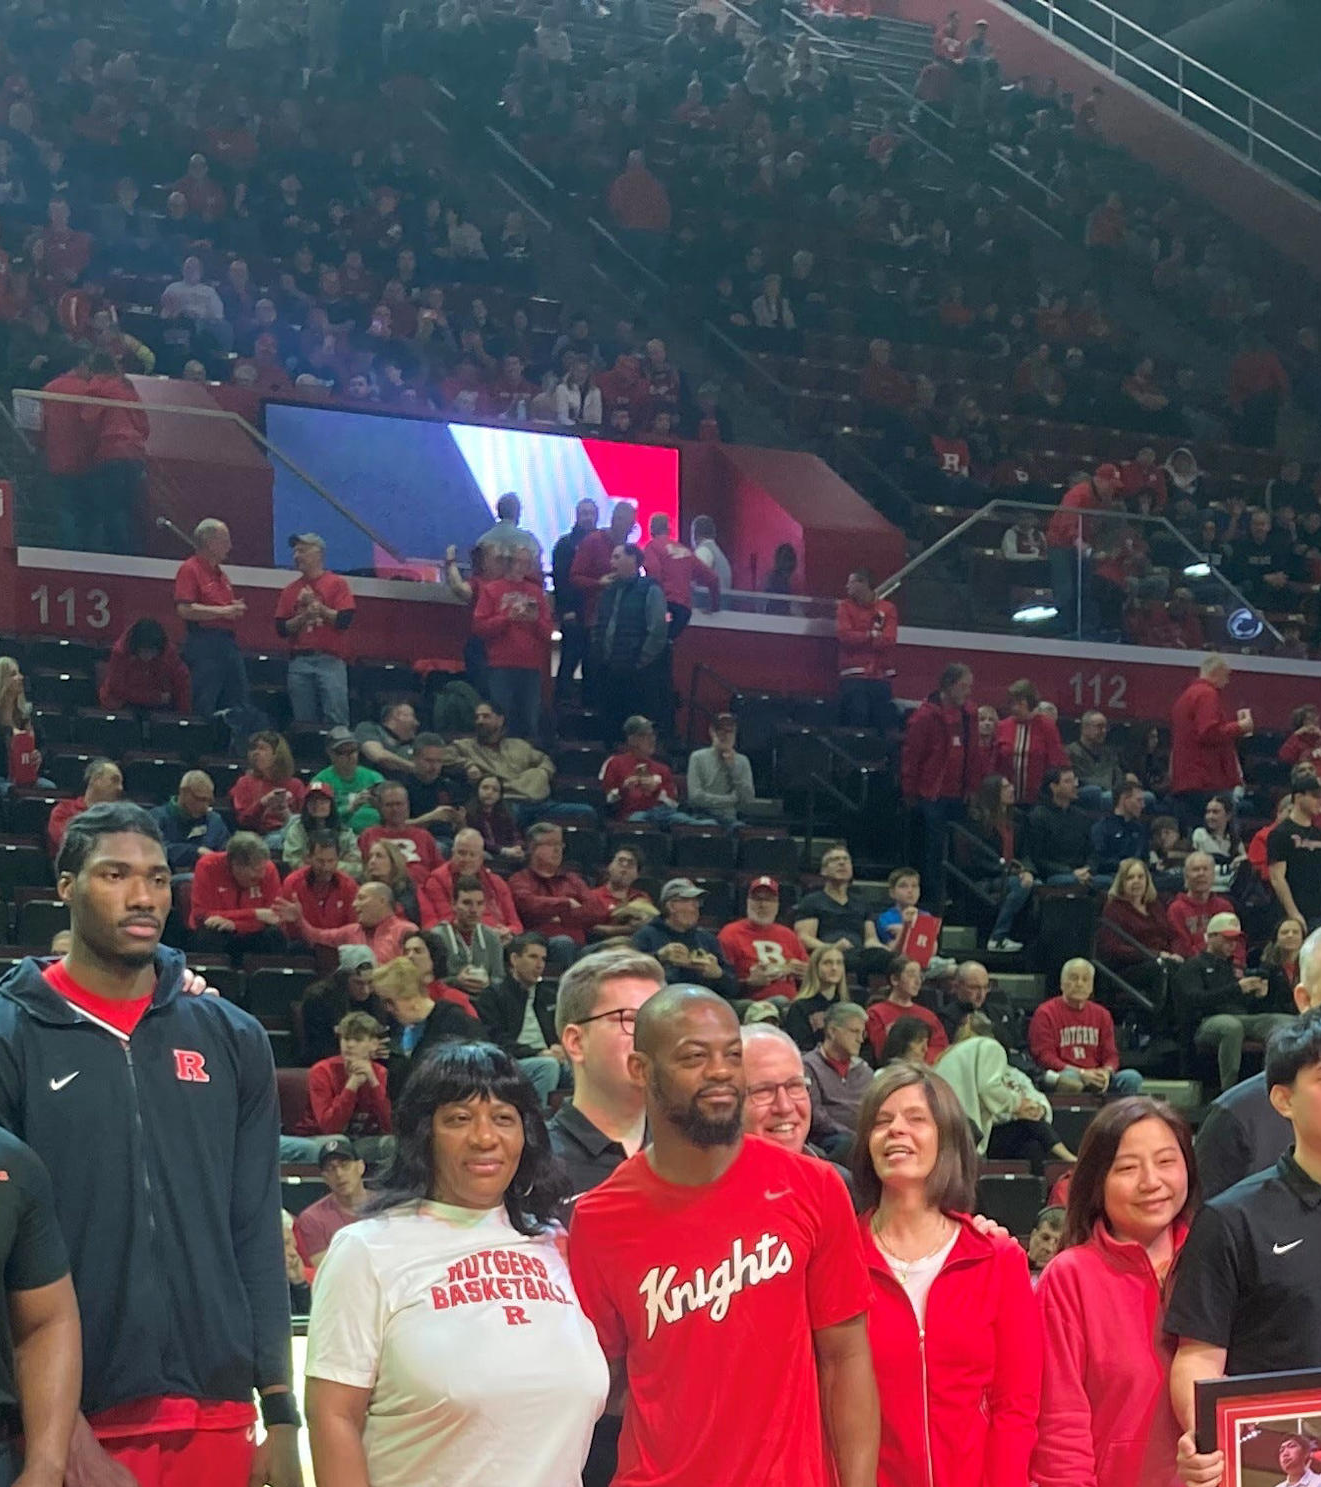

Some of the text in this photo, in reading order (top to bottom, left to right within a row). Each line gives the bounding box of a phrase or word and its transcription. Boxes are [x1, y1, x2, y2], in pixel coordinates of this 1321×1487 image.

[942, 453, 960, 472] R
[31, 585, 112, 628] 113
[1069, 672, 1127, 710] 112
[752, 940, 786, 968] R
[174, 1049, 210, 1083] R
[445, 1249, 548, 1286] RUTGERS
[430, 1277, 574, 1312] BASKETBALL
[638, 1232, 794, 1341] Knights
[504, 1305, 532, 1326] R
